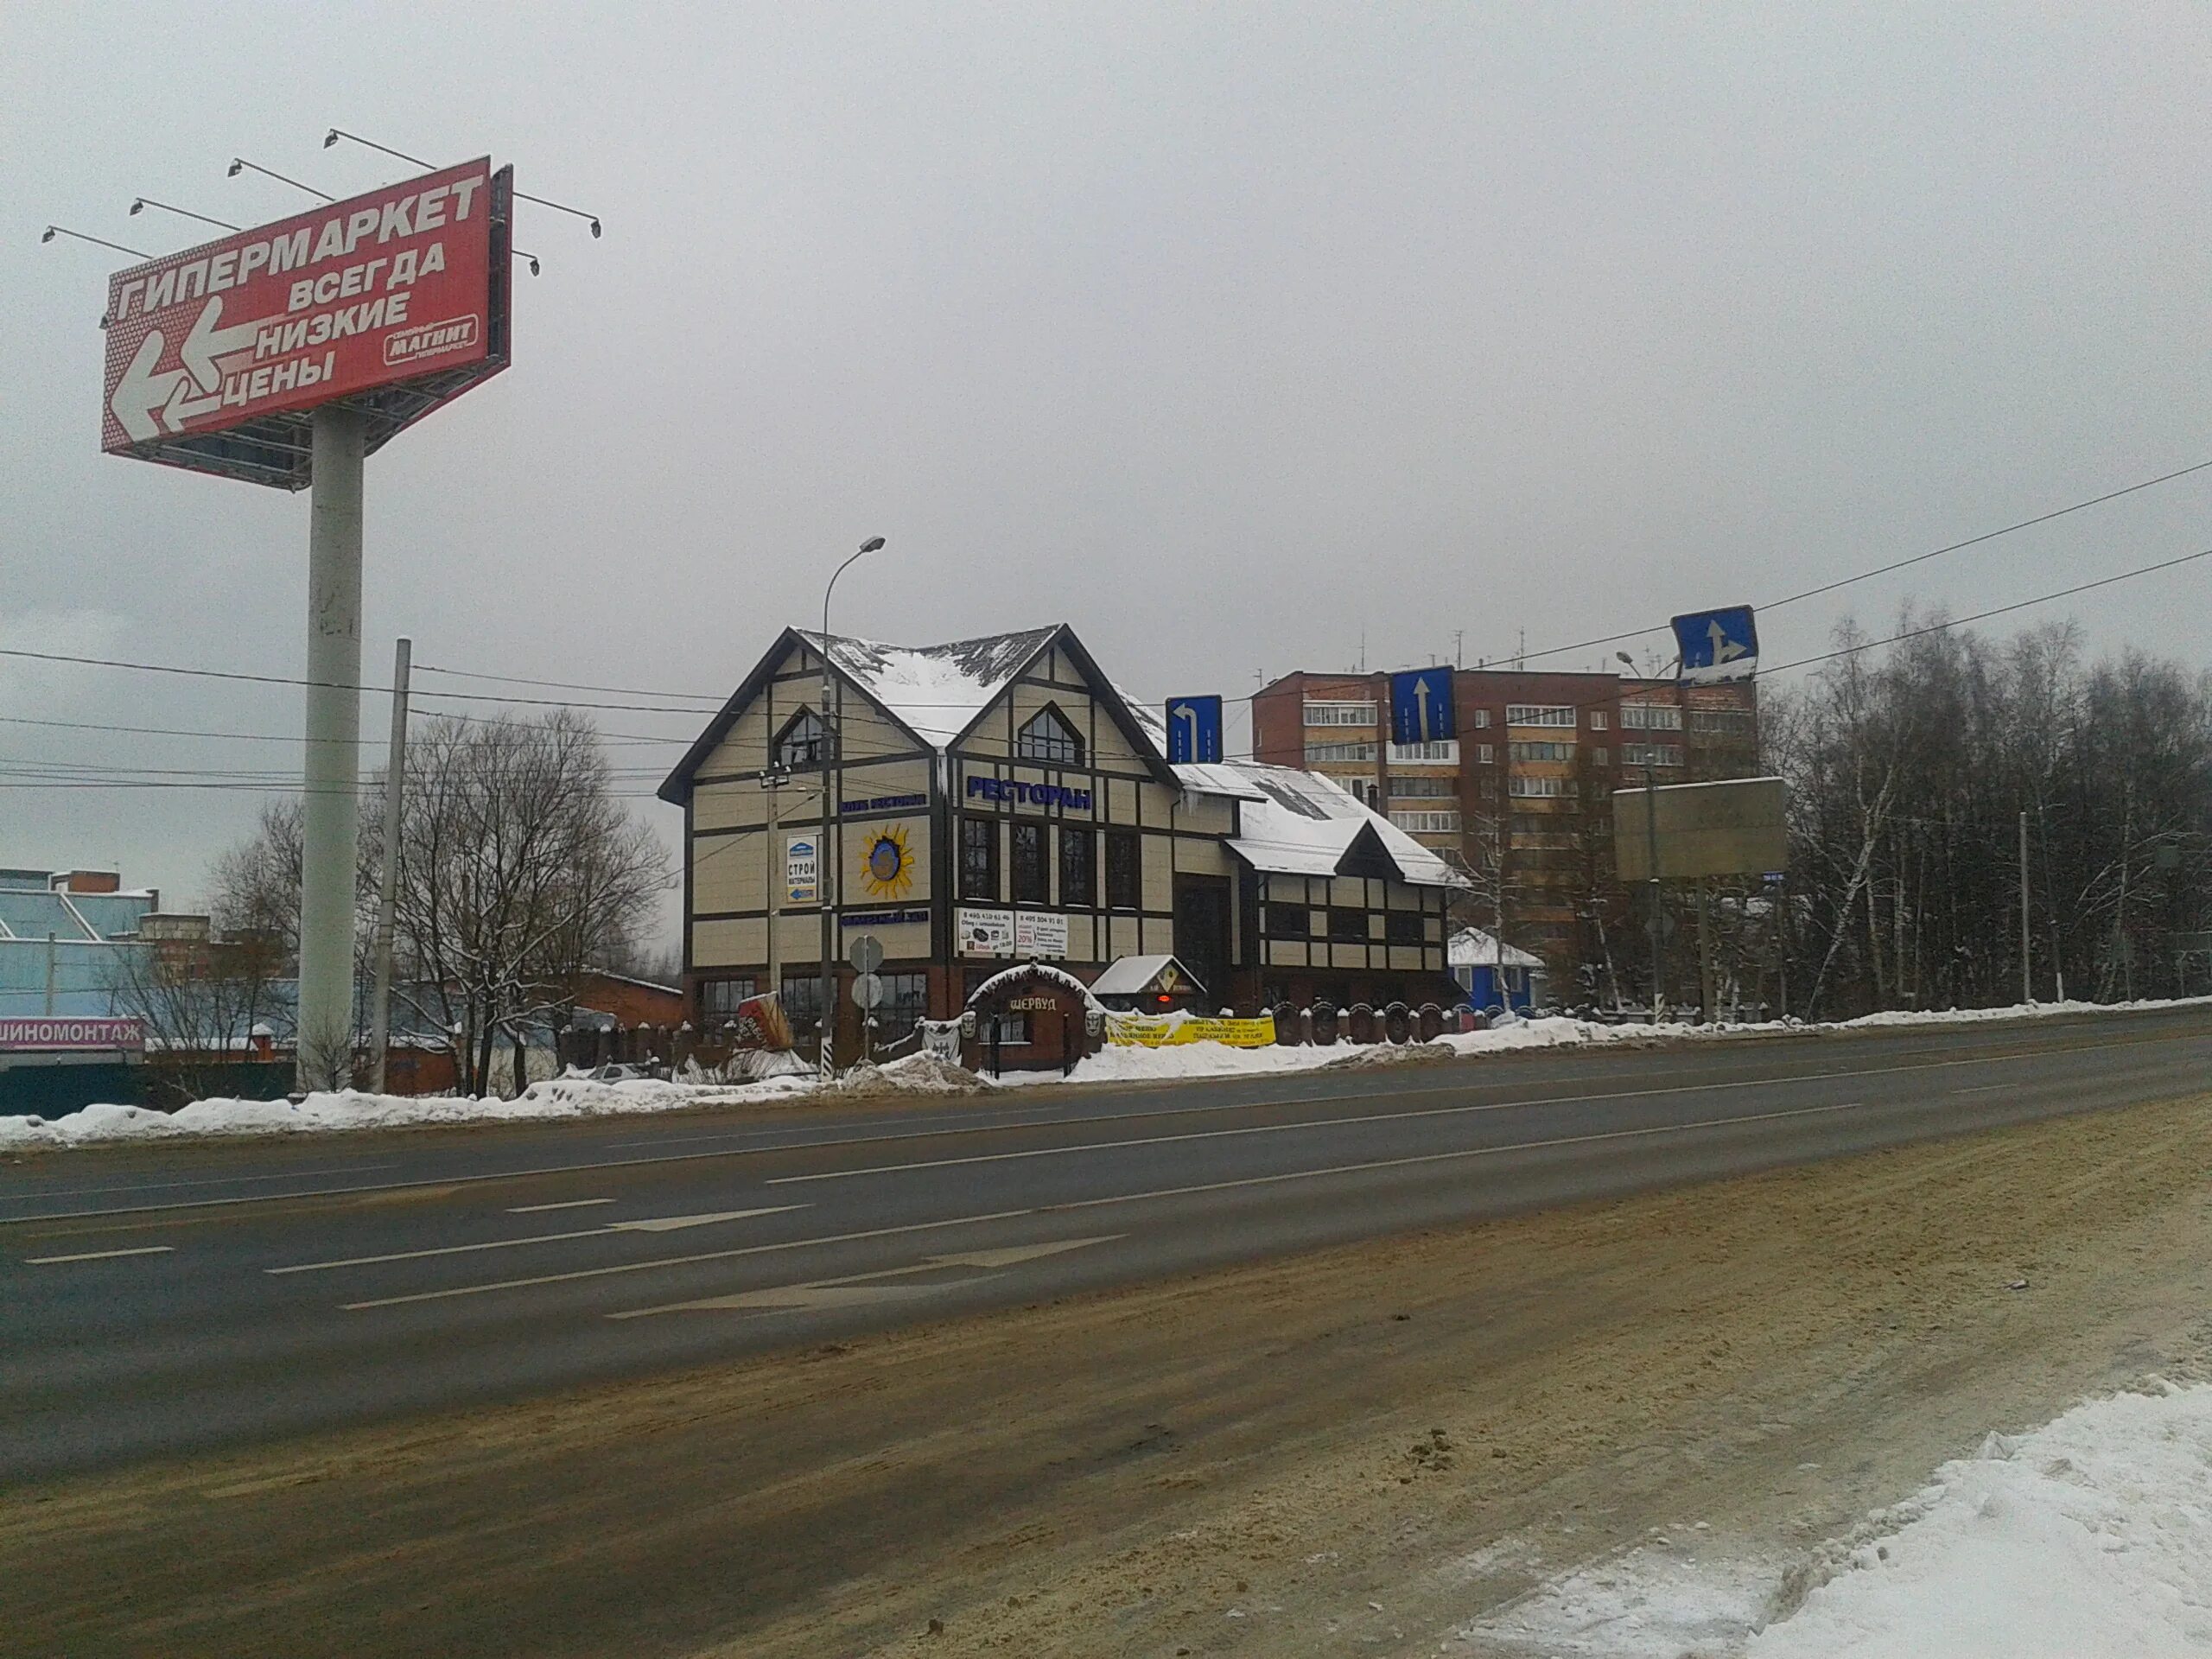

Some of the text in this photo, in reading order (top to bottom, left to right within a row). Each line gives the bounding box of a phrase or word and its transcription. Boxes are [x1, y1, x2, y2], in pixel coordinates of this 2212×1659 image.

[118, 175, 485, 321] ГИПЕРМАРКЕТ
[288, 243, 446, 313] ВСЕГДА
[255, 292, 411, 359] НИЗКИЕ
[389, 322, 474, 357] МАГНИТ
[221, 351, 336, 407] ЦЕНЫ
[967, 775, 1091, 810] РЕСТОРАН
[788, 860, 816, 875] СТРОЙ
[788, 876, 816, 885] МАТЕРИАЛЫ
[1010, 997, 1057, 1011] ШЕРВУД
